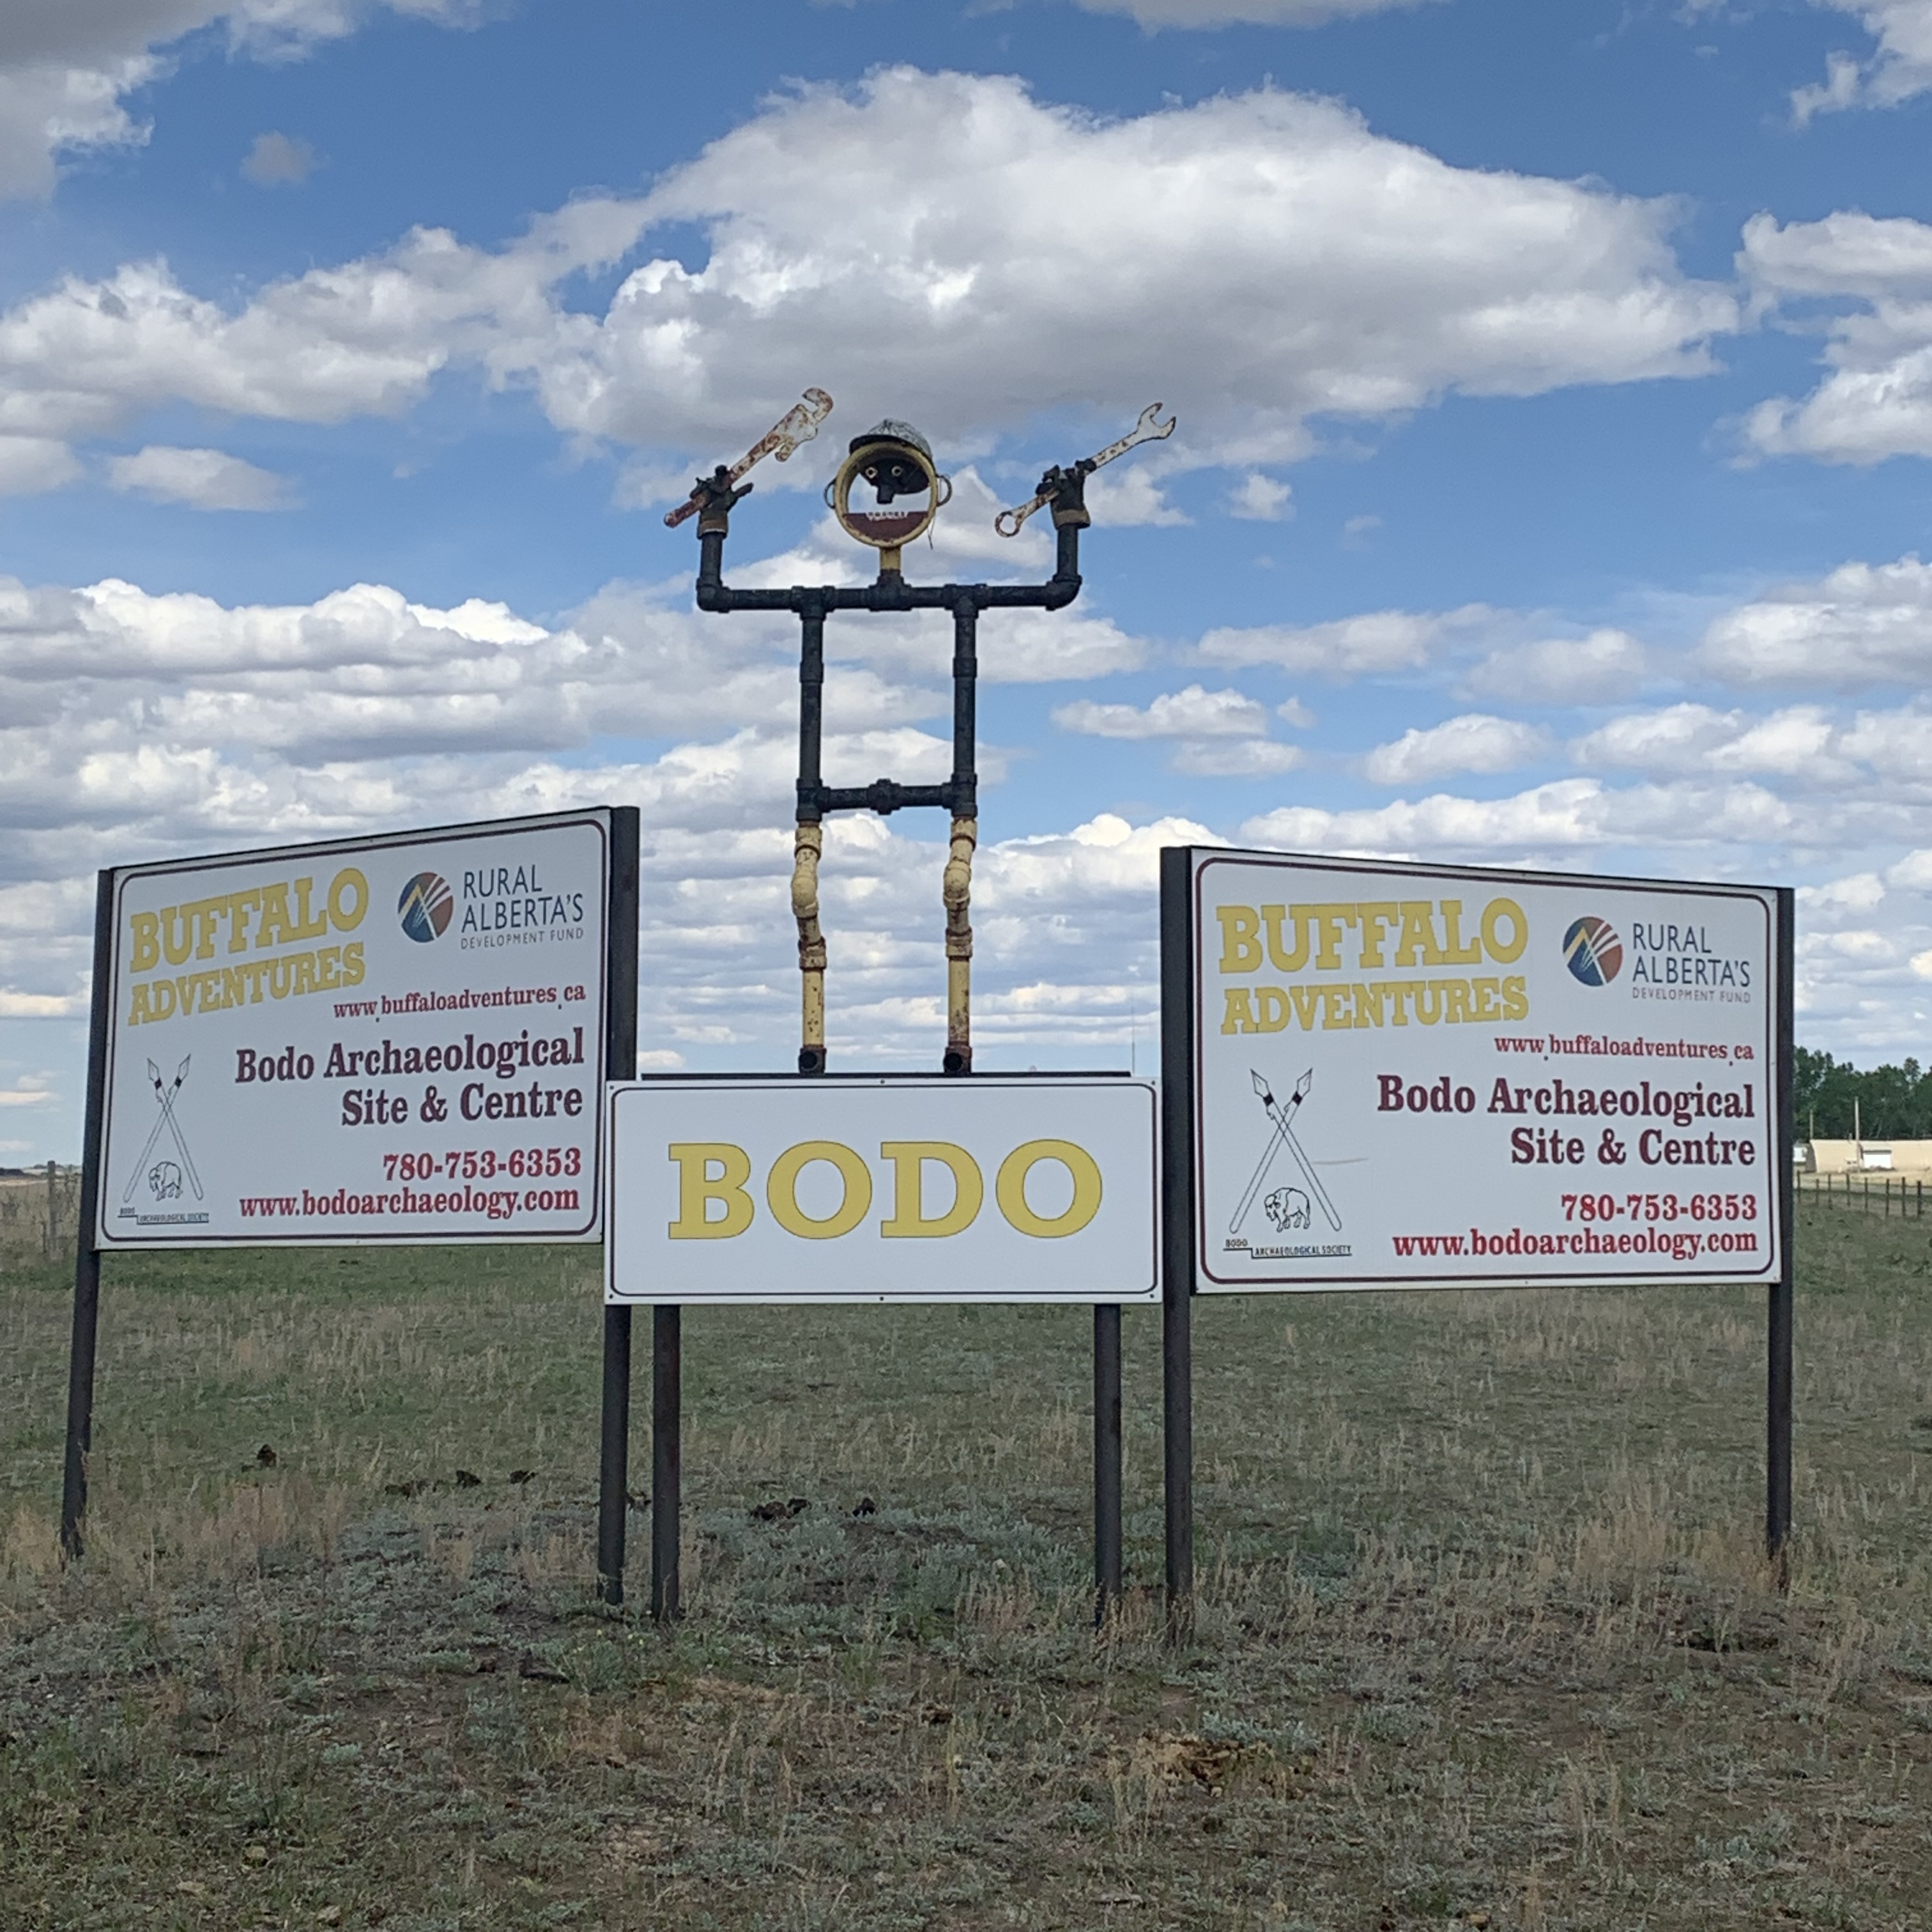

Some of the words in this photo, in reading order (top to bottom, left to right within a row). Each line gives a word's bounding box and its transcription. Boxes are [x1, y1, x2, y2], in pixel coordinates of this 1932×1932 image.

[464, 864, 542, 899] RURAL
[130, 867, 369, 973] BUFFALO
[461, 893, 584, 933] ALBERTA'S
[461, 931, 544, 949] DEVELOPMENT
[550, 928, 584, 941] FUND
[1216, 898, 1528, 974] BUFFALO
[1633, 923, 1712, 954] RURAL
[128, 942, 365, 1025] ADVENTURES
[1632, 955, 1751, 987] ALBERTA'S
[333, 984, 586, 1023] www.buffaloadventures.ca
[1220, 976, 1529, 1035] ADVENTURES
[1632, 987, 1715, 1002] DEVELOPMENT
[1720, 991, 1751, 1003] FUND
[234, 1046, 315, 1084] Bodo
[323, 1027, 585, 1080] Archaeological
[1494, 1034, 1755, 1067] www.buffaloadventures.ca
[341, 1089, 409, 1126] Site
[420, 1085, 448, 1123] &
[459, 1080, 583, 1119] Centre
[1376, 1074, 1476, 1114] Bodo
[1487, 1078, 1756, 1126] Archaeological
[382, 1147, 581, 1181] 780-753-6353
[1510, 1127, 1585, 1165] Site
[1597, 1128, 1627, 1165] &
[1638, 1128, 1756, 1166] Centre
[239, 1184, 580, 1220] www.bodoarchaeology.com
[668, 1138, 1103, 1239] BODO
[1561, 1193, 1758, 1222] 780-753-6353
[1225, 1239, 1248, 1247] BODO
[1392, 1226, 1759, 1261] www.bodoarchaeology.com
